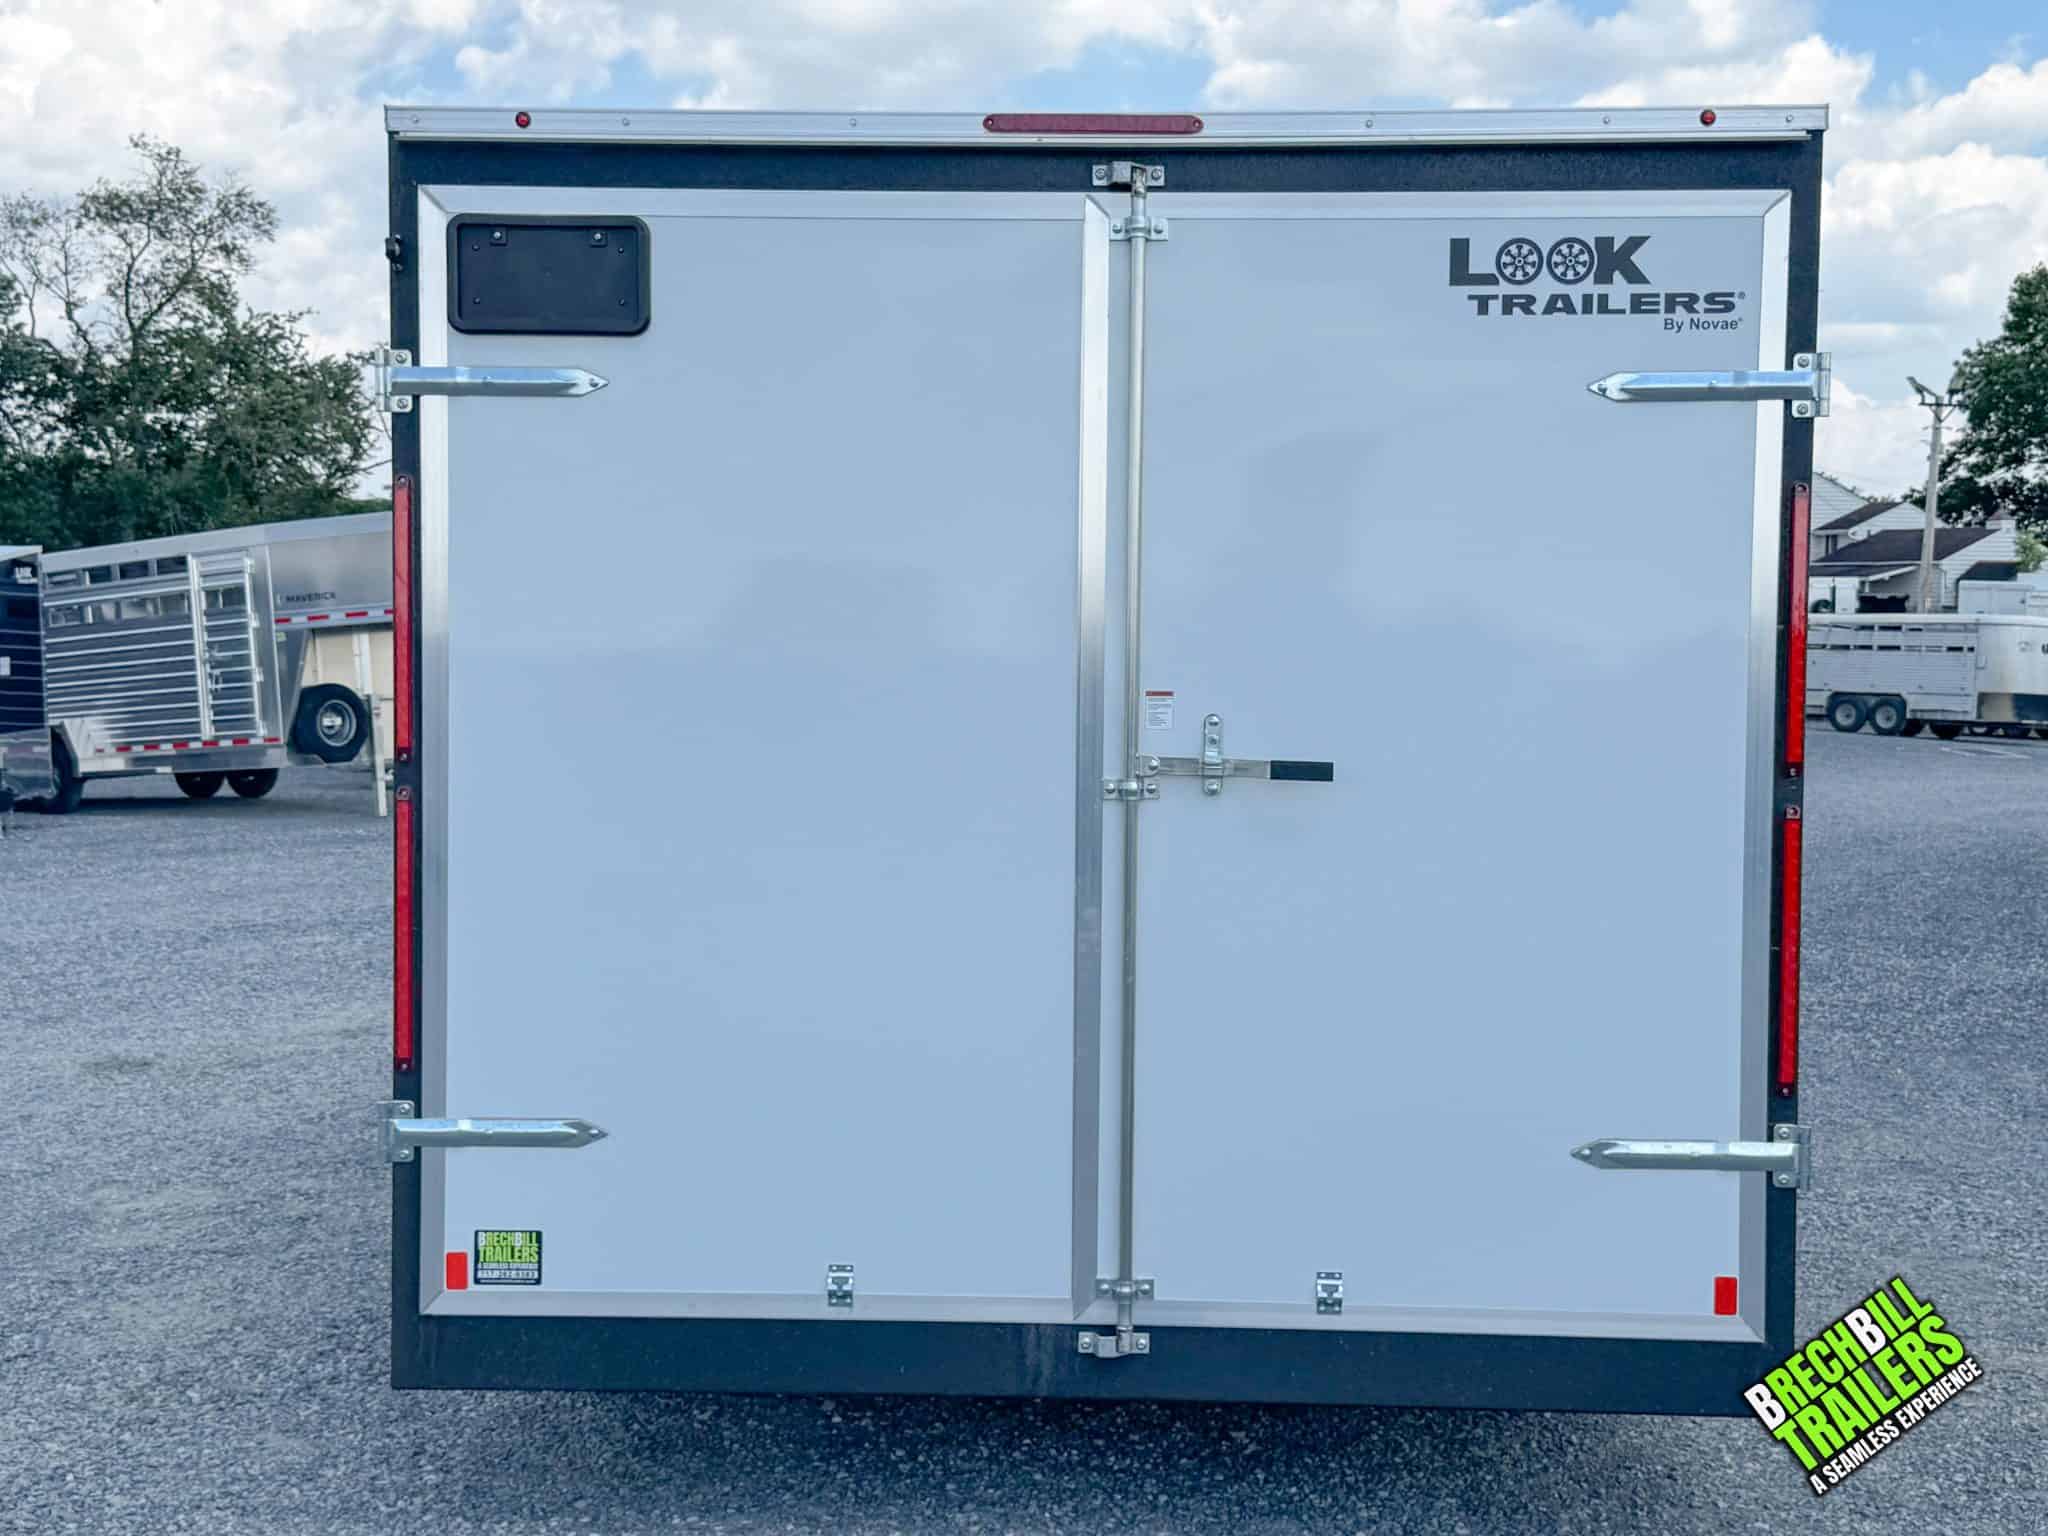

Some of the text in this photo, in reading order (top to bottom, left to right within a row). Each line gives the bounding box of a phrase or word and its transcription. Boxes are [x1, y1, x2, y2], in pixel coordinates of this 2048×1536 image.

[1449, 235, 1651, 286] LOOK
[1467, 292, 1736, 316] TRAILERS
[1663, 317, 1738, 333] By Novae
[478, 1231, 538, 1246] BRECHBILL
[479, 1246, 538, 1263] TRAILERS
